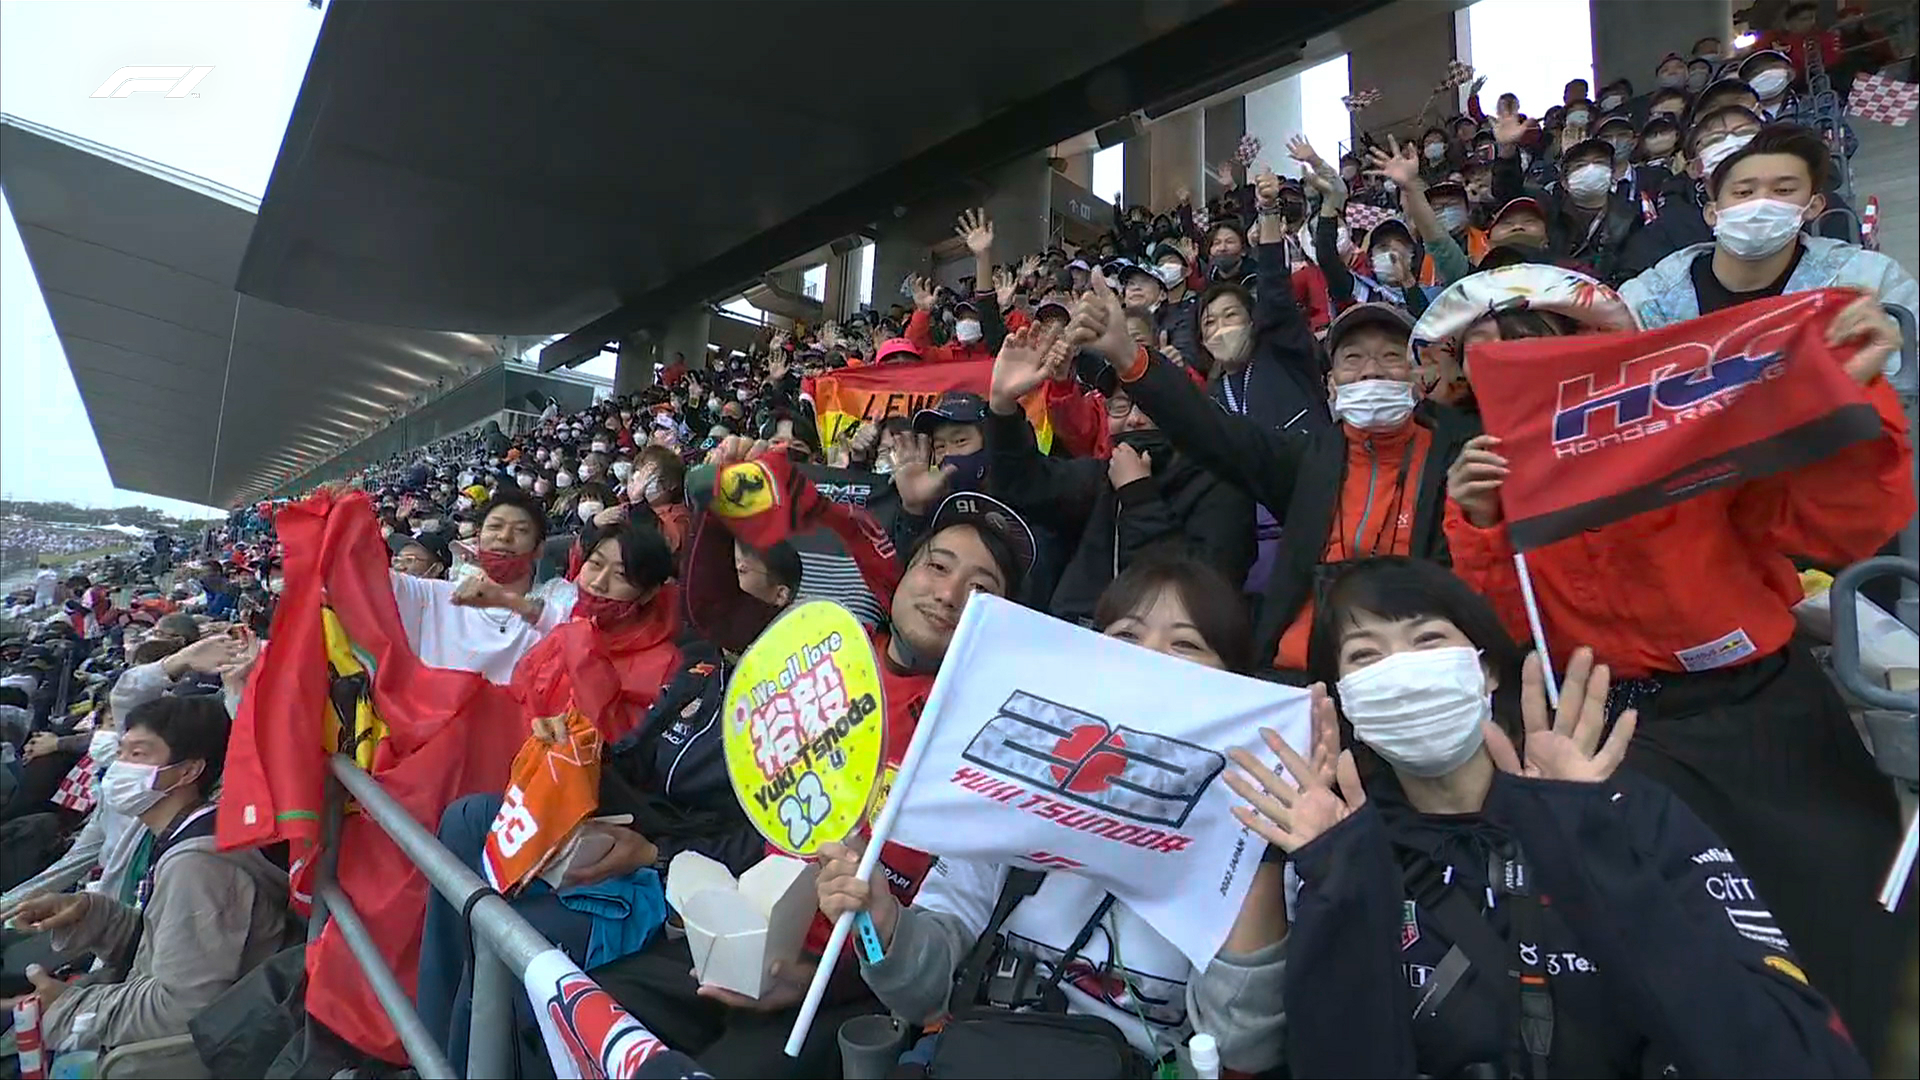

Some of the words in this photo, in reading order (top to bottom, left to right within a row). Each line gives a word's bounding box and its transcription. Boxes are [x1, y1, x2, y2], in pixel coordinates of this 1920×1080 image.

[861, 392, 938, 422] LEW
[1555, 418, 1668, 460] Honda
[750, 679, 777, 707] We
[778, 652, 801, 690] all
[801, 631, 842, 671] love
[753, 762, 797, 812] Yuki
[777, 770, 832, 850] 22
[949, 766, 1025, 804] YUKI
[1017, 794, 1195, 853] TSUNODA
[1705, 872, 1756, 900] citr
